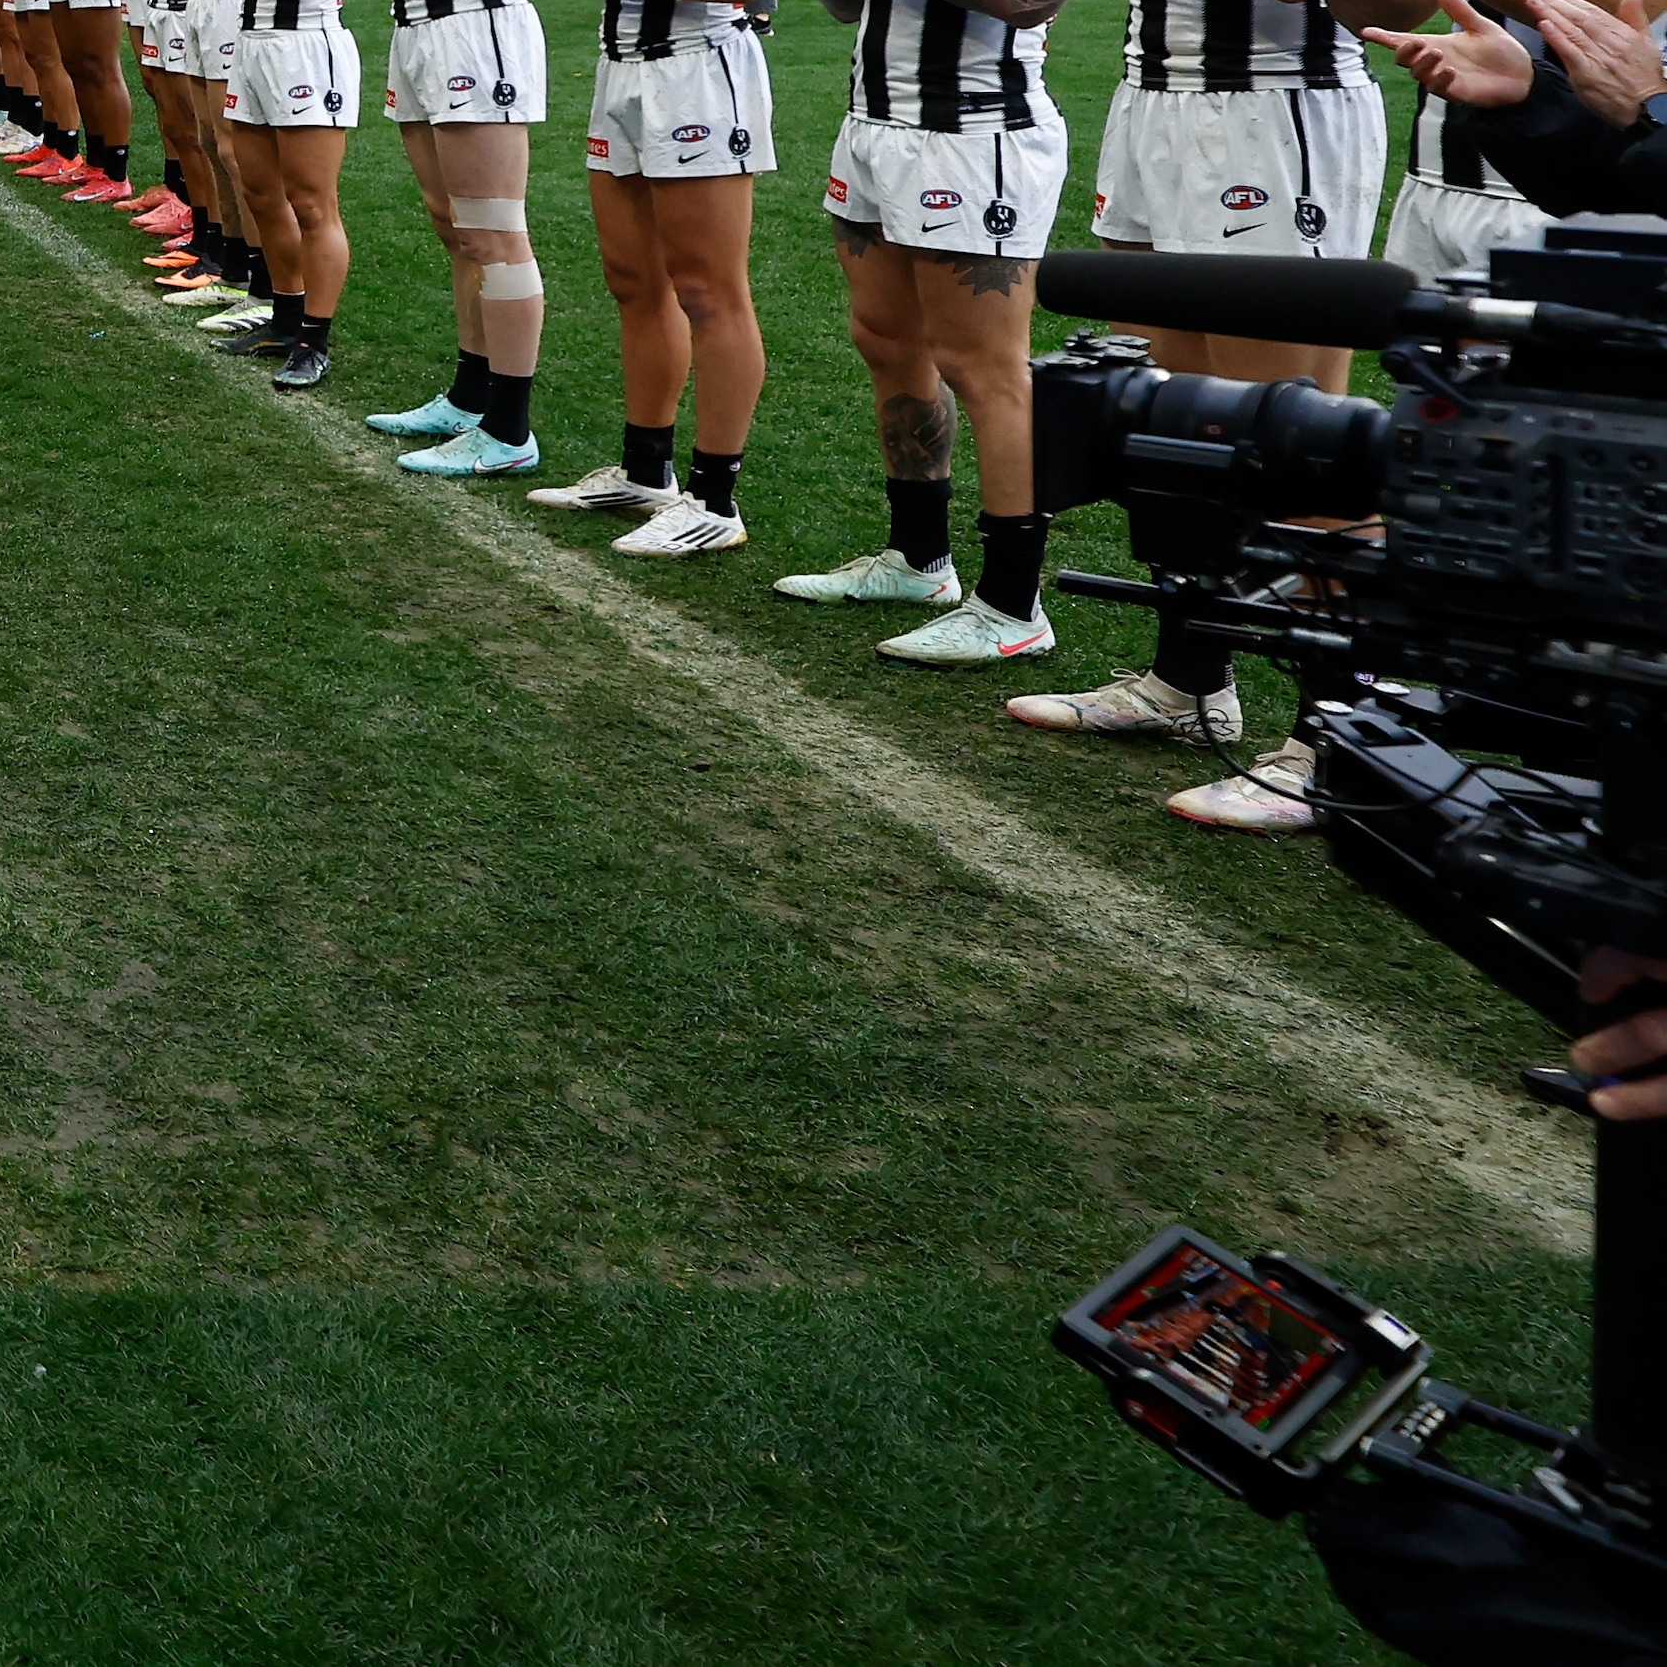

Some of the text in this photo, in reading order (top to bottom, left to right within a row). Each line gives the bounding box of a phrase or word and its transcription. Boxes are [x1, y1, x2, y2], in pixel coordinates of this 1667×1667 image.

[449, 79, 473, 90] AFL
[290, 86, 314, 97] AFL
[677, 128, 708, 140] AFL
[923, 193, 960, 207] AFL
[1223, 190, 1266, 205] AFL
